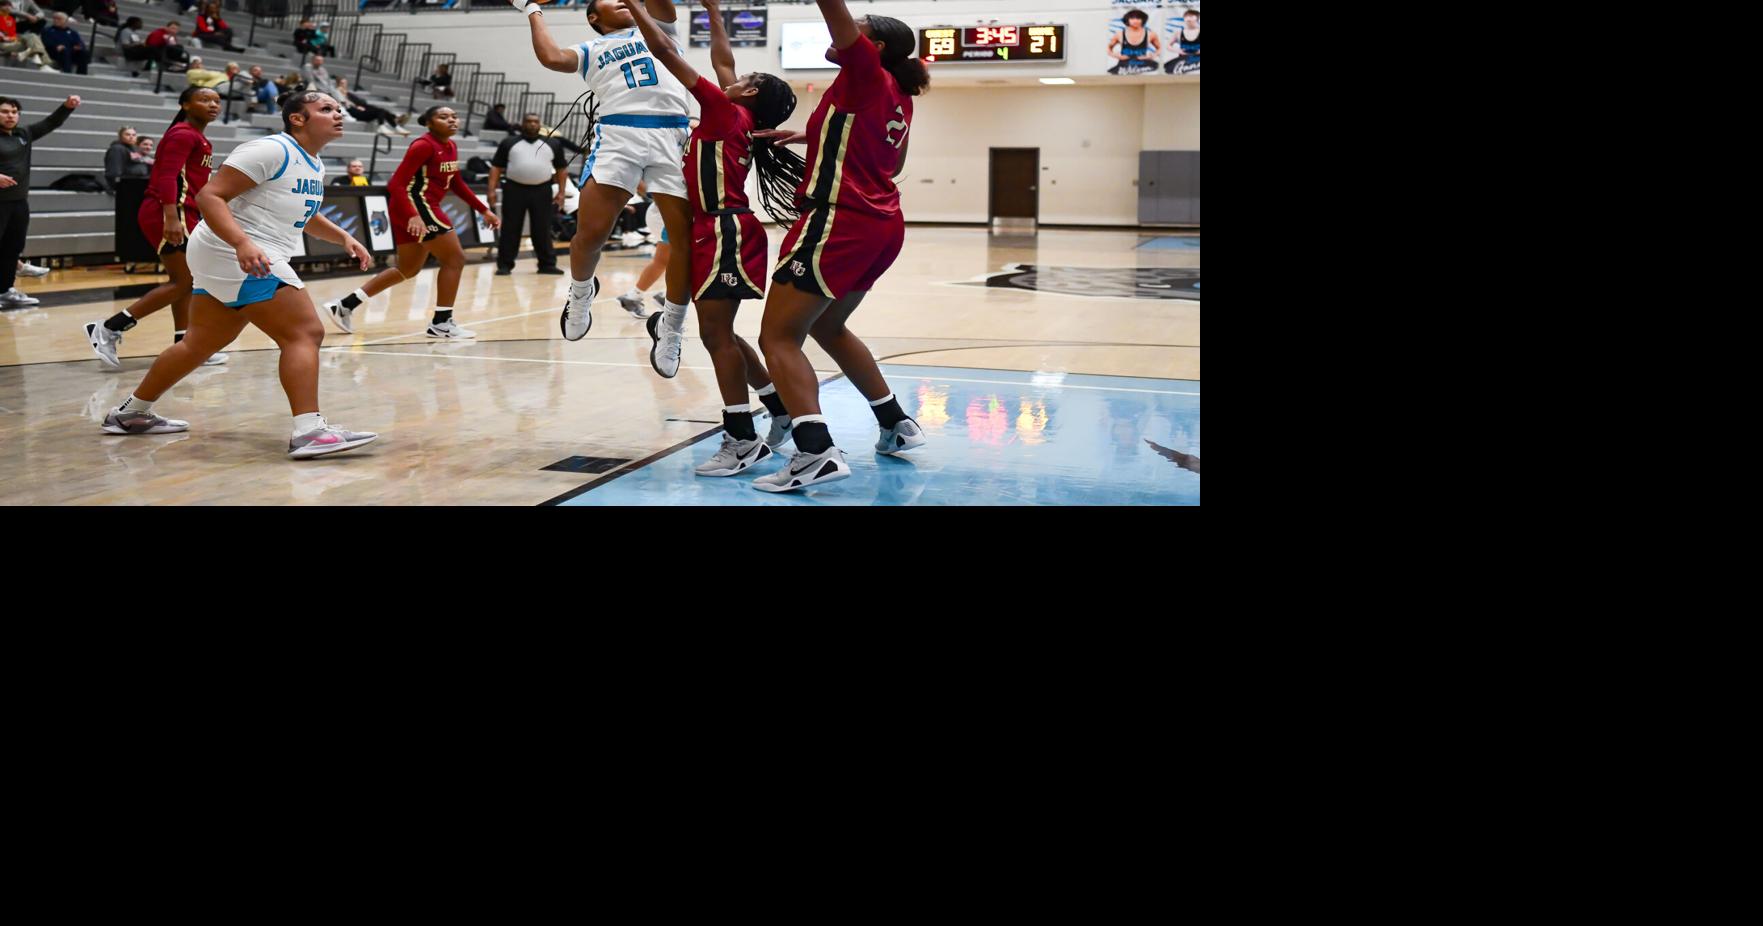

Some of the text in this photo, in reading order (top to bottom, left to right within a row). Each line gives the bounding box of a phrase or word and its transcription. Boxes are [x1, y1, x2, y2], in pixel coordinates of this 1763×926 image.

[976, 27, 1016, 44] 3:45
[930, 38, 954, 54] 69
[1030, 36, 1056, 53] 21
[597, 41, 648, 70] JAGUA
[997, 47, 1008, 60] 4
[620, 57, 658, 89] 13
[291, 179, 323, 196] JAGU
